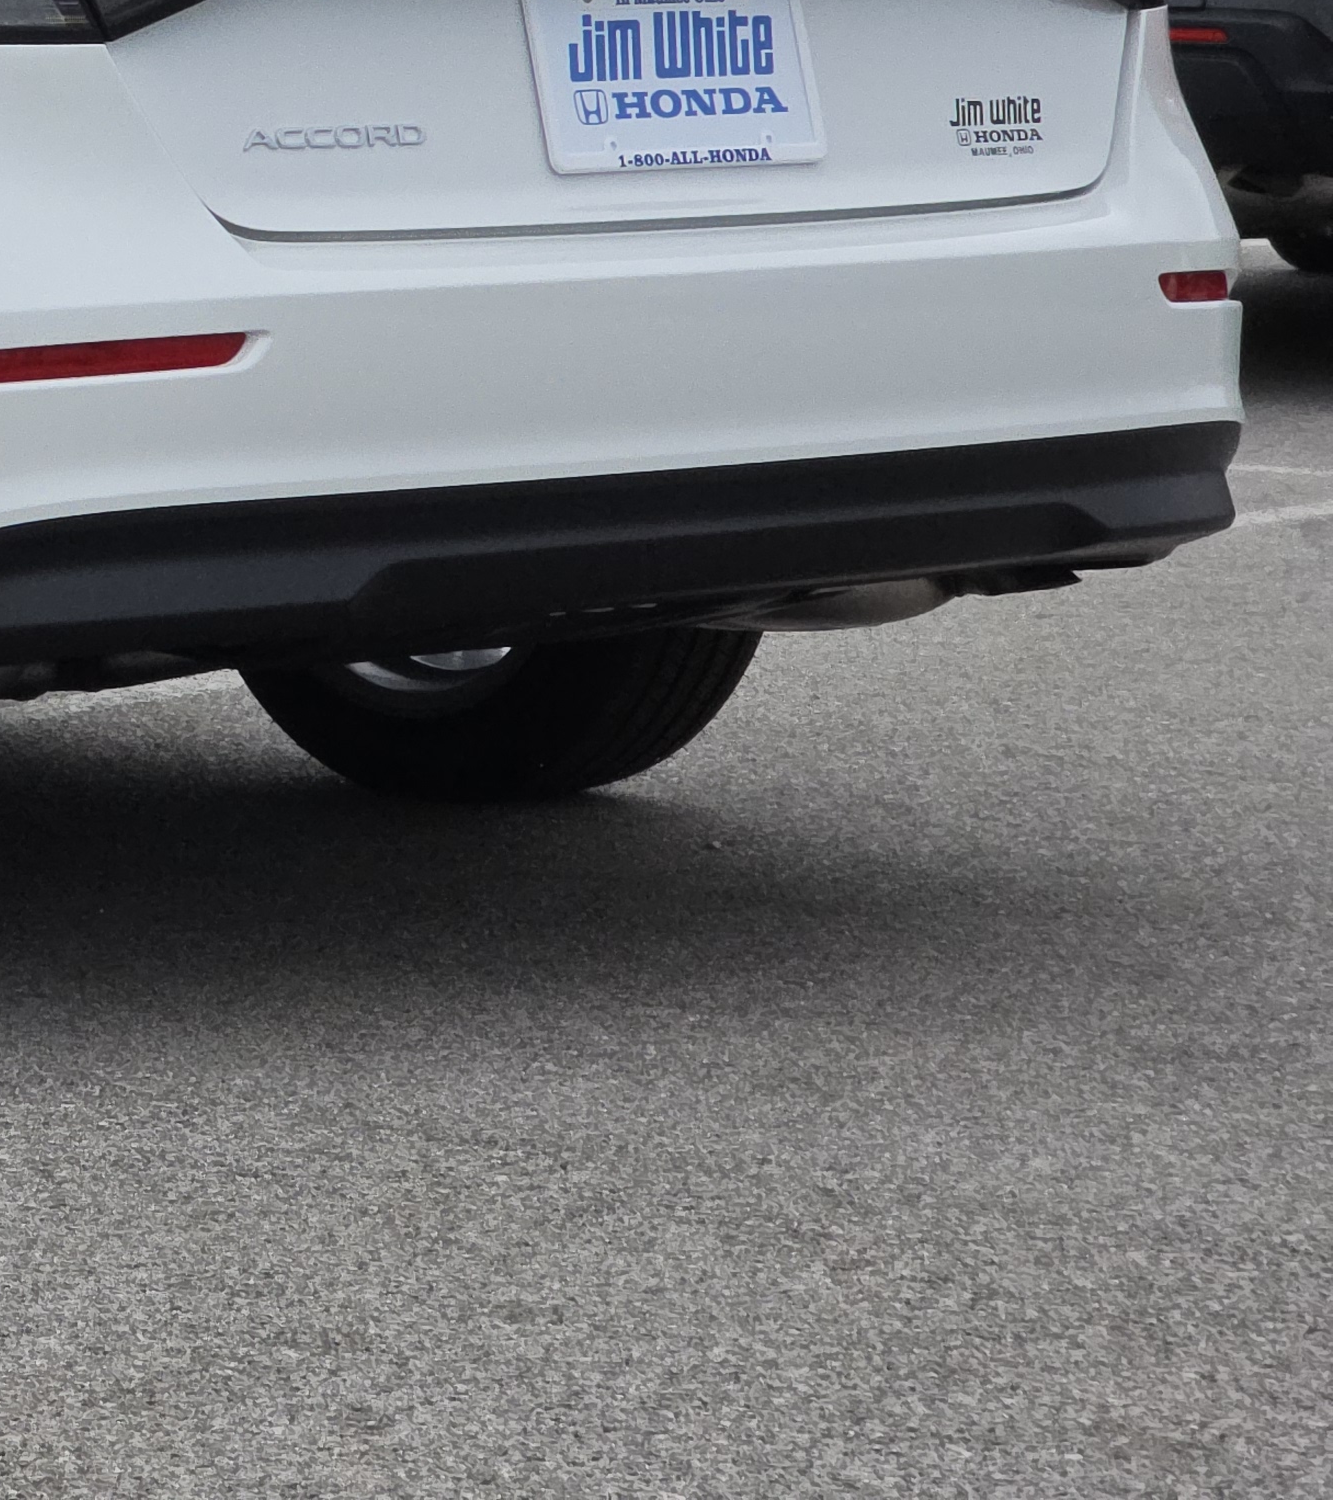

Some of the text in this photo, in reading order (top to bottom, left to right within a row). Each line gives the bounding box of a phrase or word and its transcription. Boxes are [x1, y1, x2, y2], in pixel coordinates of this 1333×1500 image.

[653, 9, 775, 79] White
[612, 86, 789, 120] HONDA
[242, 124, 427, 152] ACCORD
[973, 128, 1044, 143] HONDA
[618, 148, 773, 169] 1-800-ALL-HONDA
